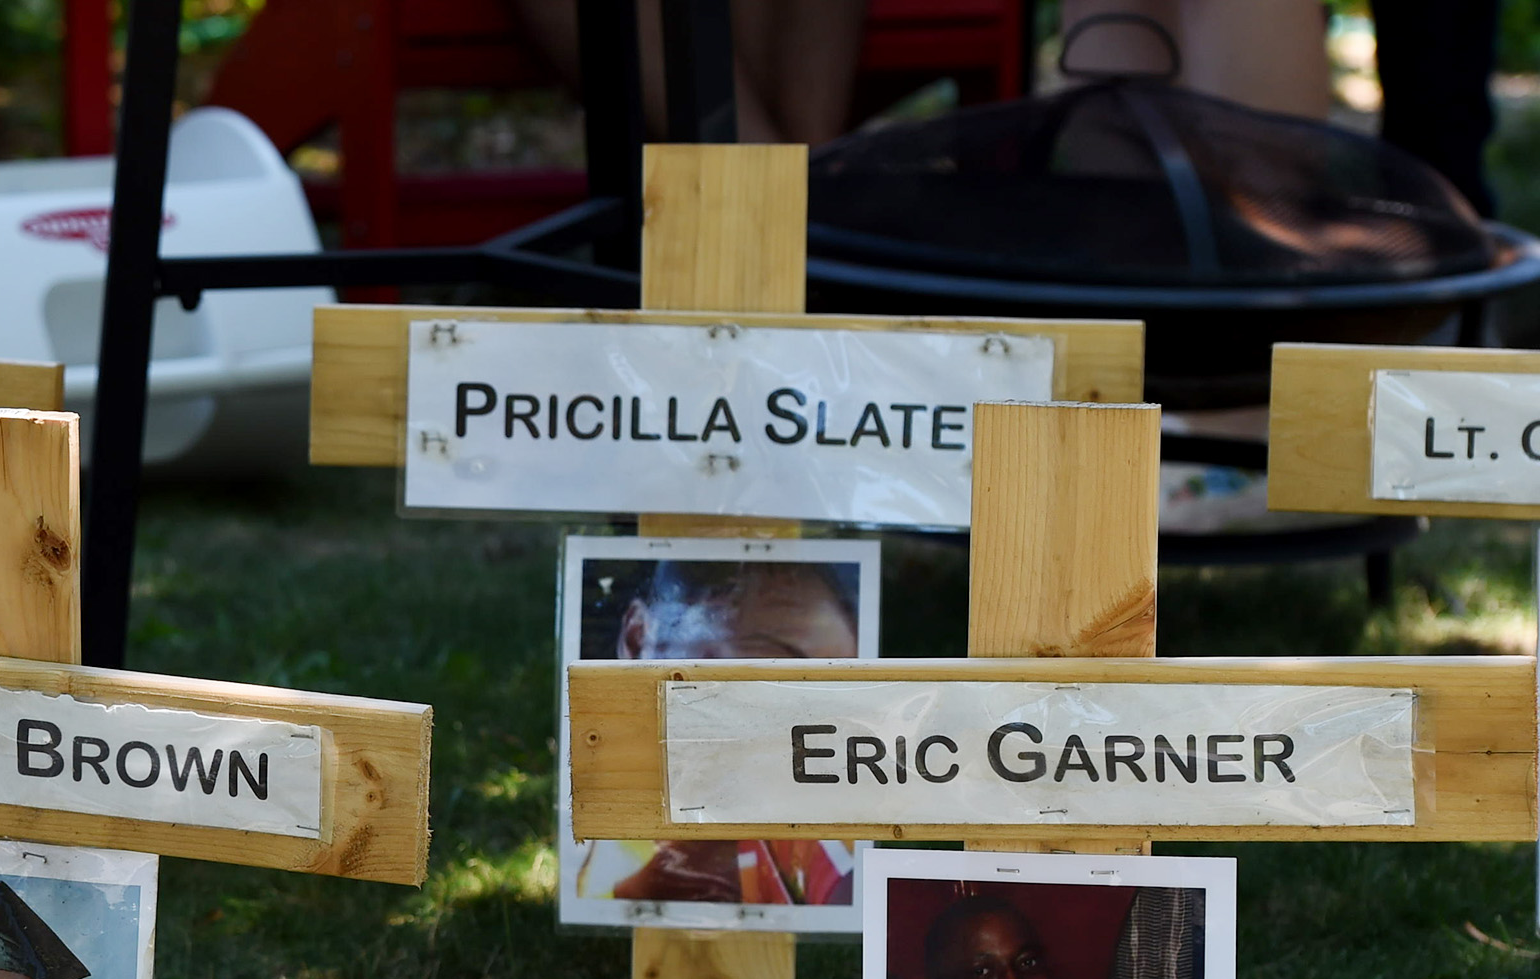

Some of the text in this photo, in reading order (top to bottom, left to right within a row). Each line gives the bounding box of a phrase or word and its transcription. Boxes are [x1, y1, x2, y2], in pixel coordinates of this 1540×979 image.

[455, 382, 742, 444] PRICILLA
[16, 718, 269, 801] BROWN
[790, 721, 1296, 785] ERIC GARNER
